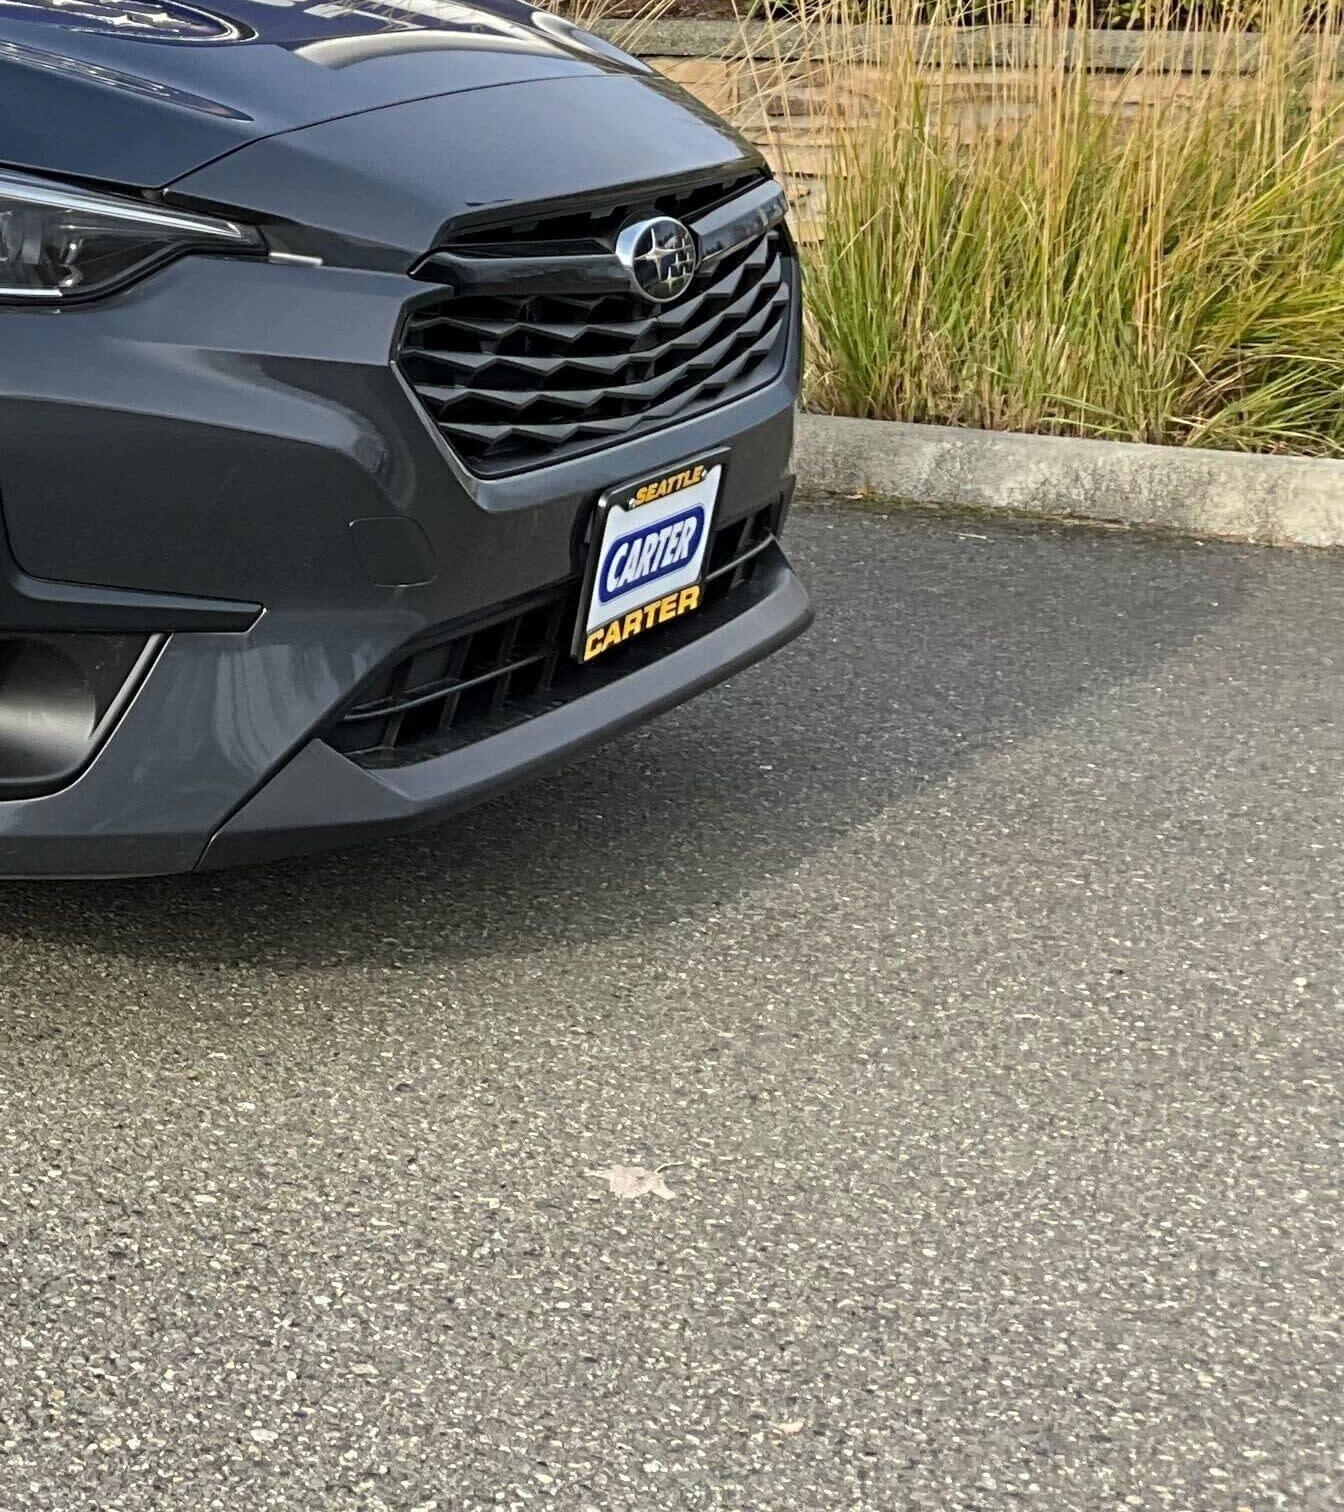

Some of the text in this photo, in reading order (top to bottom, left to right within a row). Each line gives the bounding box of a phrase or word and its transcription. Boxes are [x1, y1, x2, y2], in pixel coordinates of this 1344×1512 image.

[634, 465, 704, 504] SEATTLE
[606, 515, 698, 593] CARTER
[583, 584, 702, 662] CARTER
